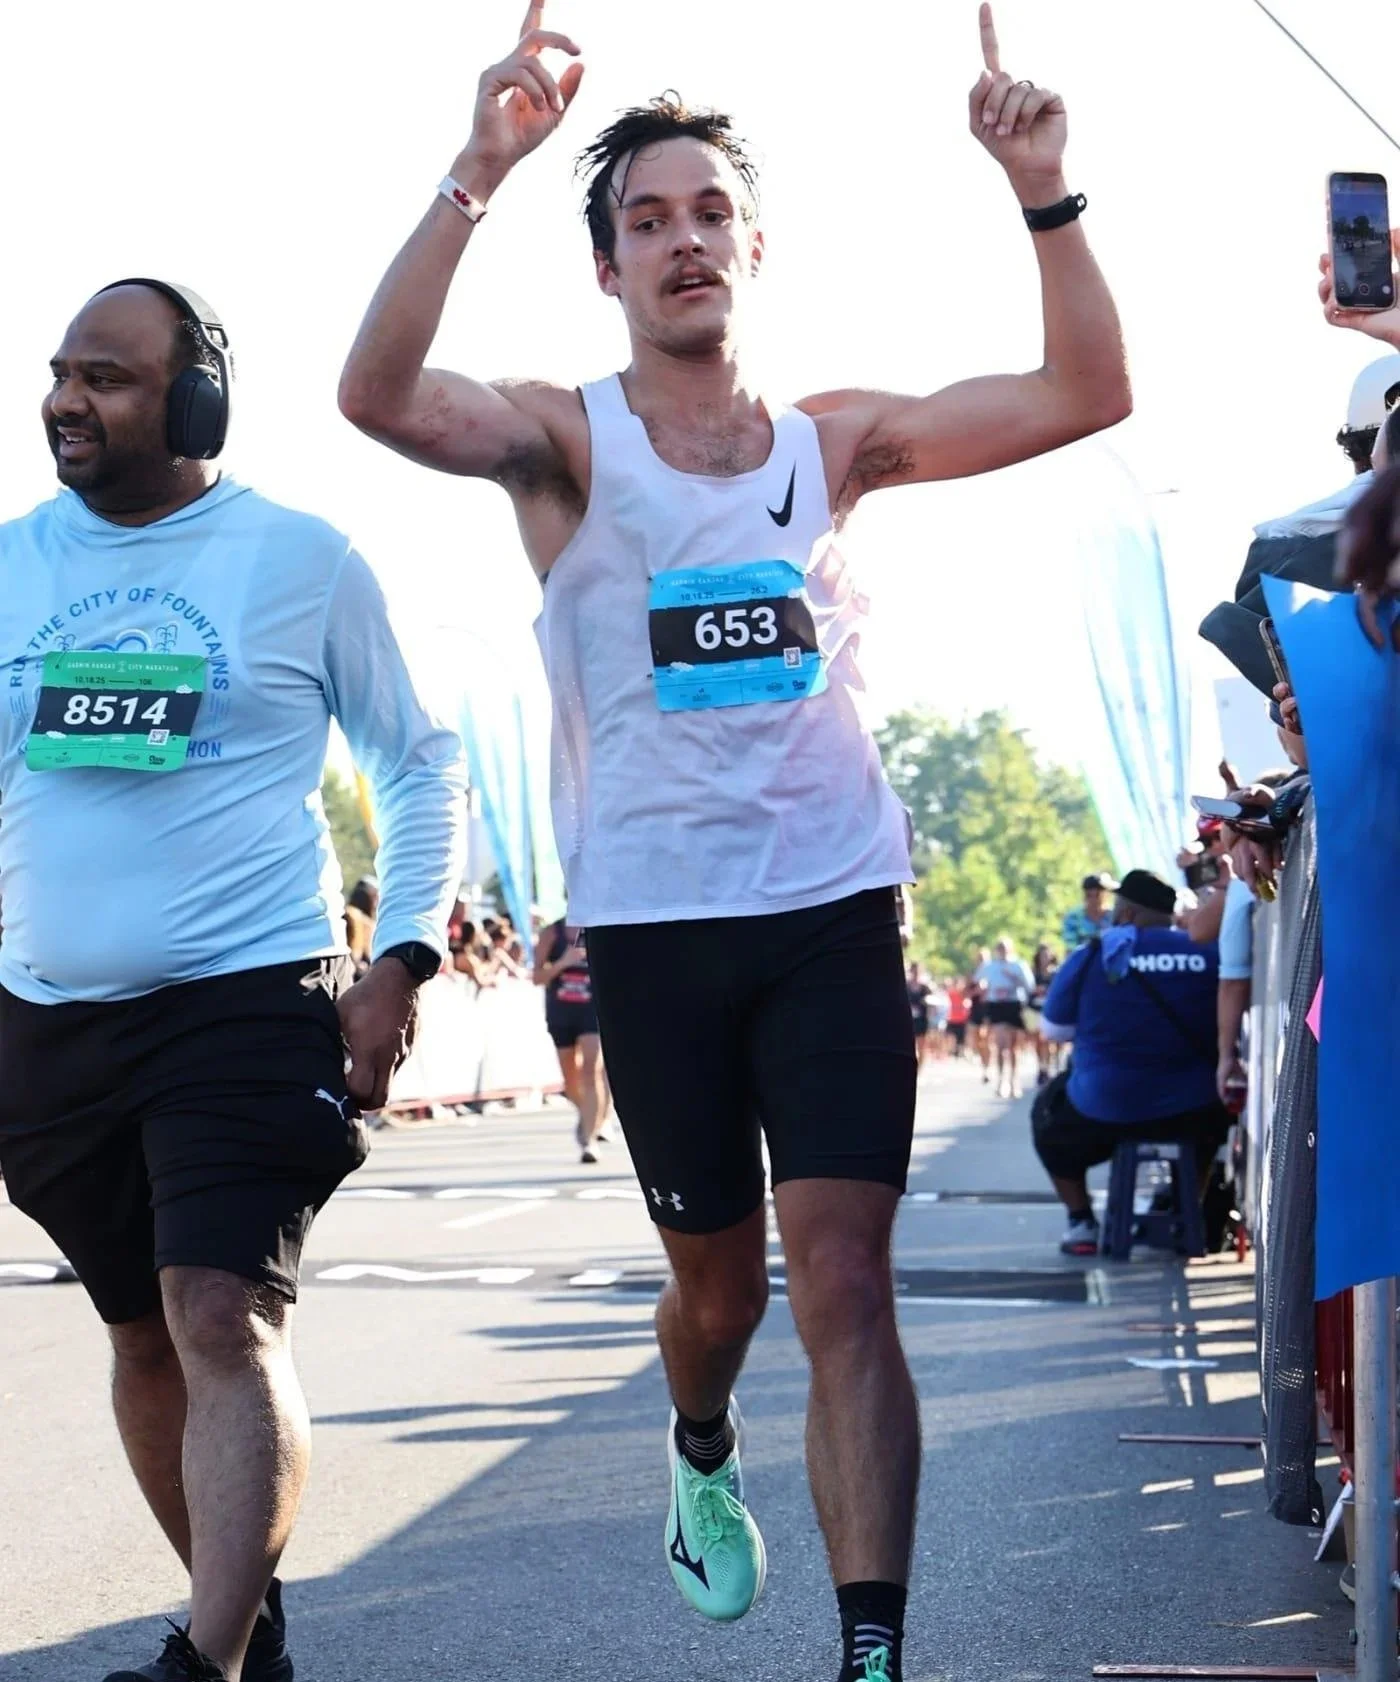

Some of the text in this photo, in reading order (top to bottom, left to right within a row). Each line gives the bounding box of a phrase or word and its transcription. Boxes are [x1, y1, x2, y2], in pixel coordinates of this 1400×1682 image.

[751, 585, 769, 595] 26.2
[27, 614, 64, 650] THE
[69, 589, 118, 618] CITY
[128, 587, 156, 603] OF
[160, 592, 230, 691] FOUNTAINS
[694, 606, 778, 650] 653
[63, 694, 169, 726] 8514
